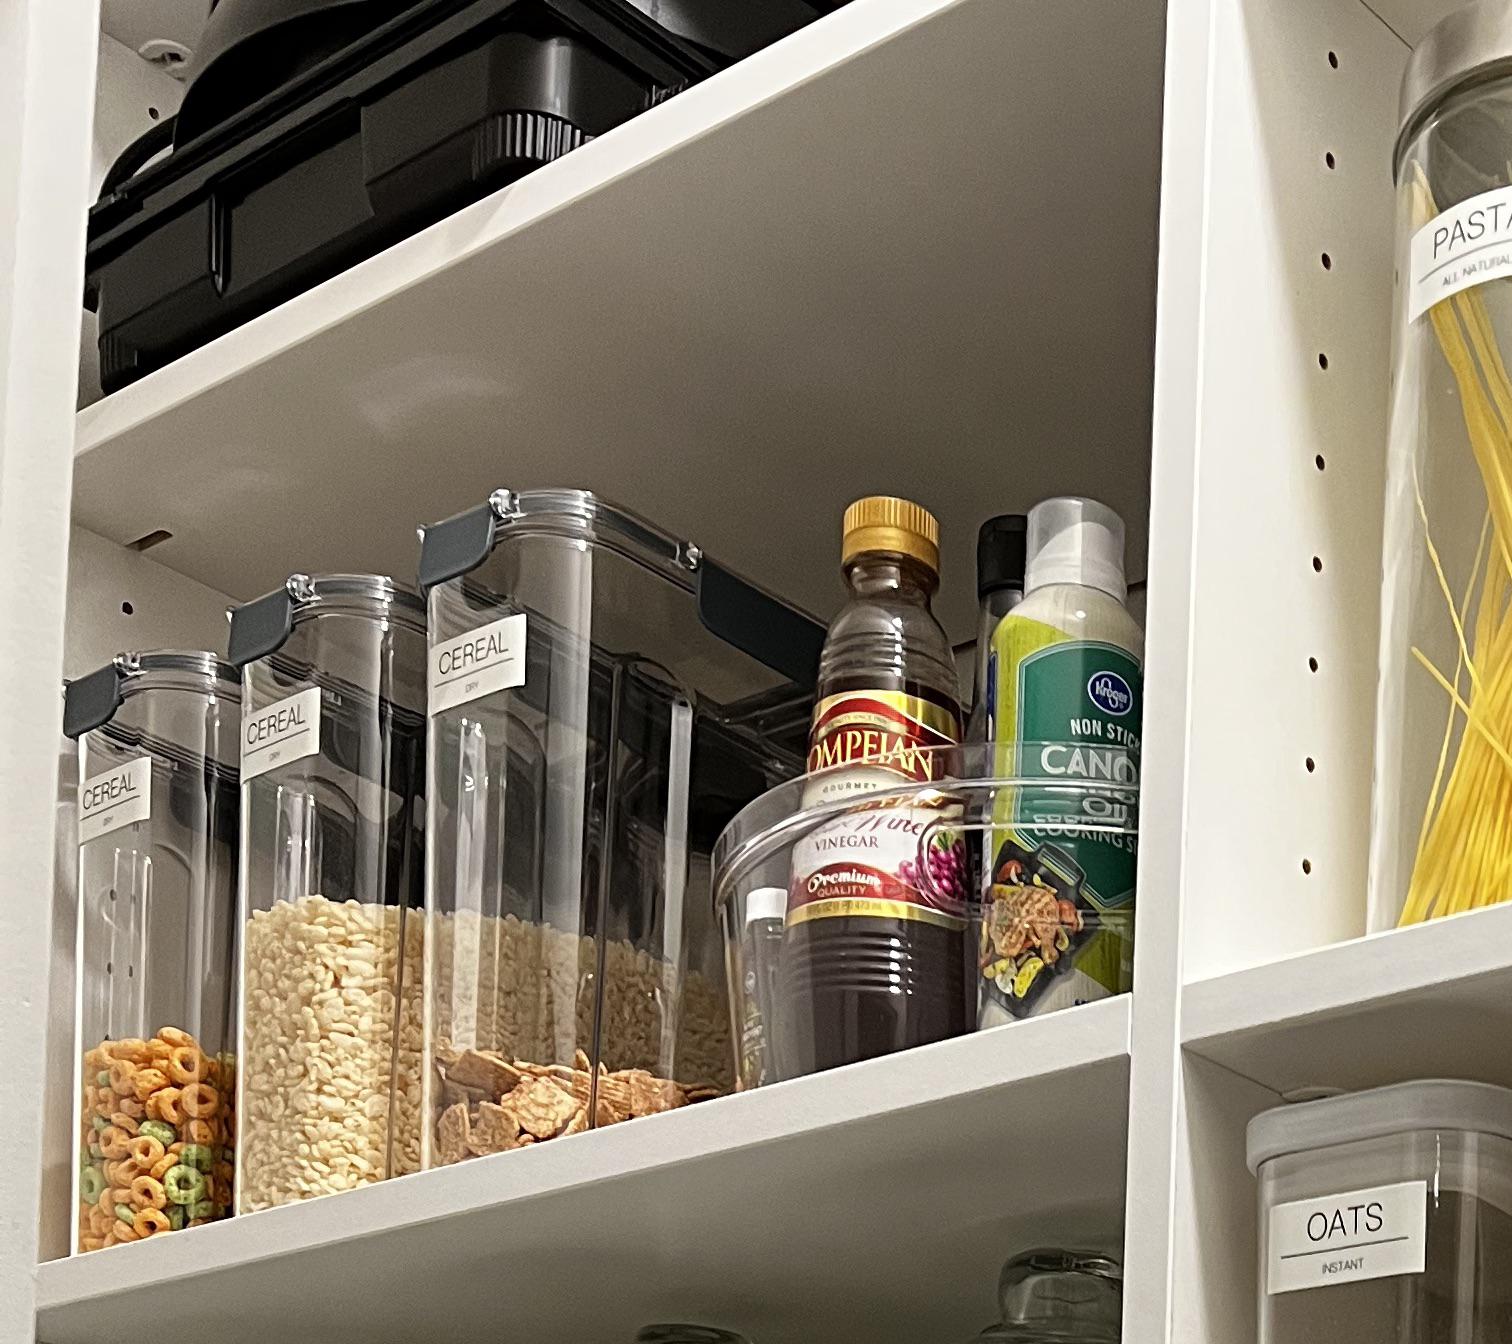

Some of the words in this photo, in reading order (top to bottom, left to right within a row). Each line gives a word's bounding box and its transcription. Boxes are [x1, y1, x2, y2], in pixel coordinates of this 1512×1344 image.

[439, 632, 509, 675] CEREAL
[246, 705, 306, 745] CEREAL
[1070, 718, 1102, 736] NON
[808, 729, 933, 782] OMPEIAN
[82, 772, 136, 810] CEREAL
[815, 835, 879, 852] VINEGAR
[808, 868, 882, 893] Premium
[817, 885, 867, 898] QUALITY
[1306, 1202, 1384, 1242] OATS
[1321, 1257, 1365, 1275] INSTANT
